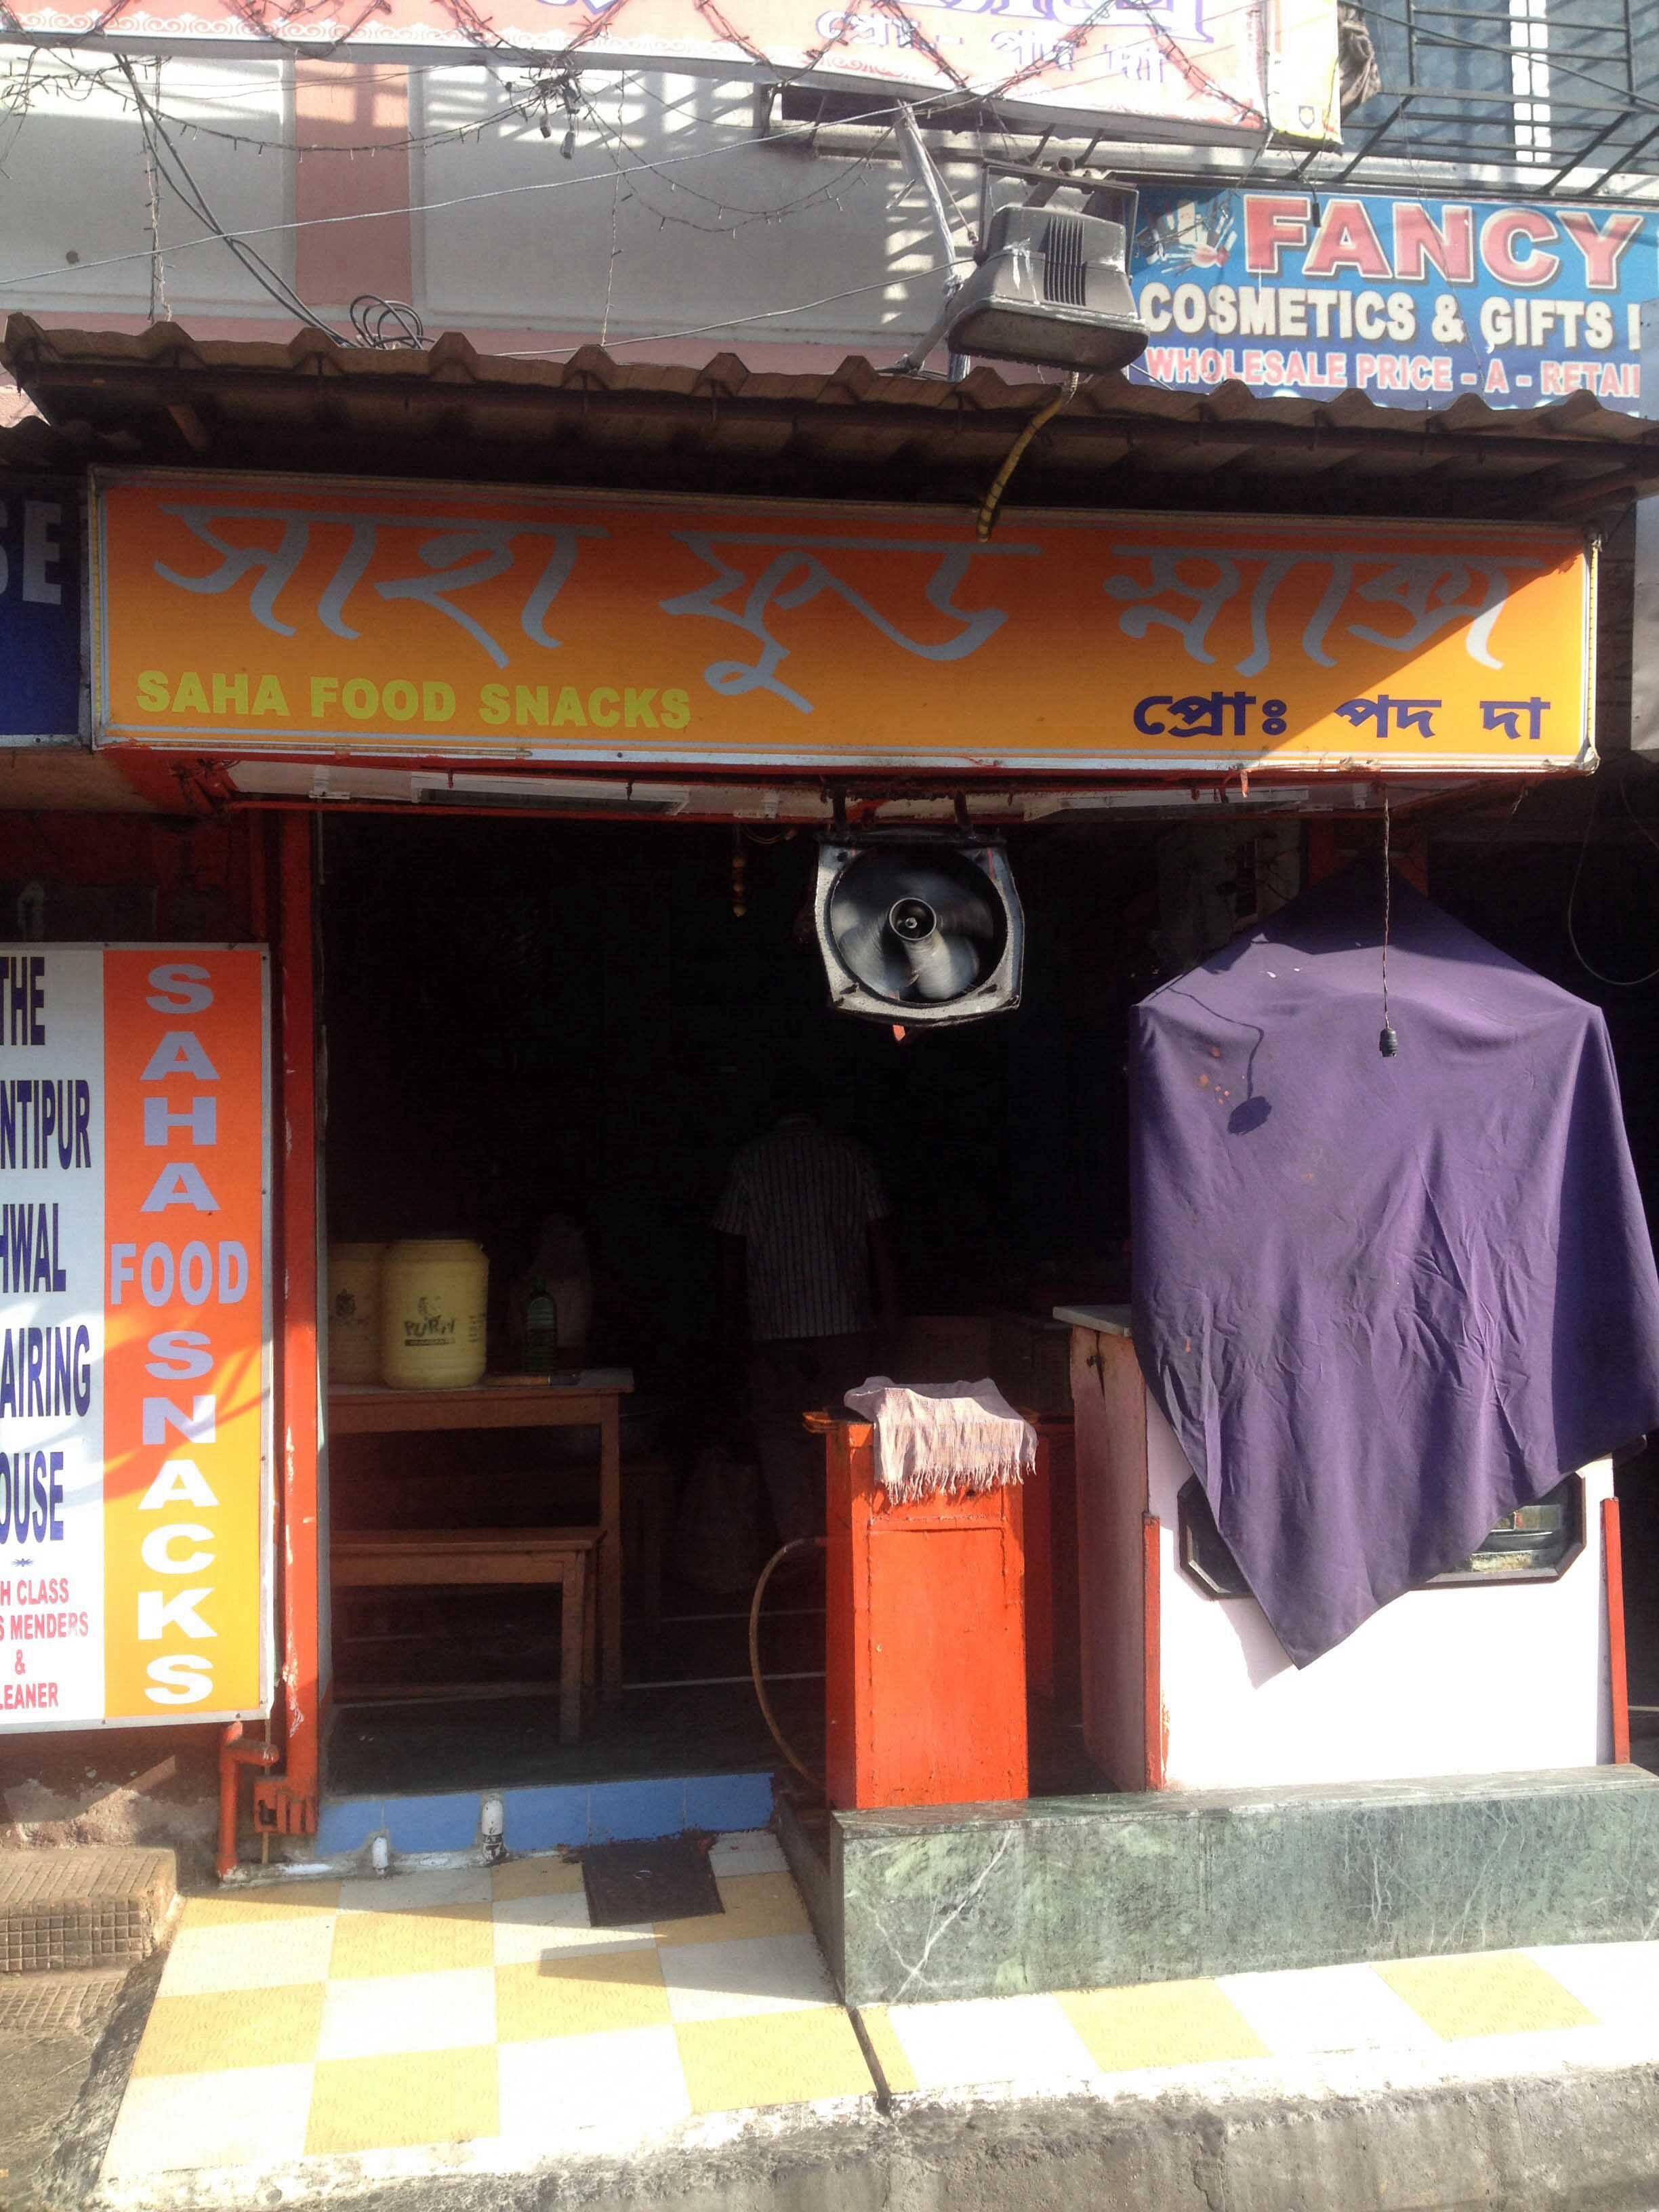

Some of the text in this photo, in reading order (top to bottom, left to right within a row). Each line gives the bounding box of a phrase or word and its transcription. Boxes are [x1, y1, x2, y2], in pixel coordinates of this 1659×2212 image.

[1244, 194, 1645, 290] FANCY
[1139, 282, 1416, 340] COSMETICS
[1431, 293, 1467, 344] &
[1479, 296, 1614, 350] GIFTS
[1145, 346, 1347, 388] WHOLESALE
[1357, 353, 1454, 392] PRICE
[1484, 358, 1510, 394] A
[153, 502, 609, 670] সাহা
[658, 531, 1044, 716] ফুড
[135, 670, 693, 731] SAHA FOOD SNACKS
[1132, 691, 1552, 740] প্রোঃ পদ দা
[140, 962, 221, 1213] SAHA
[0, 1080, 91, 1170] NTIPUR
[110, 1240, 249, 1308] FOOD
[0, 1324, 91, 1418] AIRING
[138, 1330, 221, 1705] SNACKS
[10, 1611, 89, 1641] MENDERS
[16, 1578, 69, 1606] CLASS
[14, 1649, 26, 1675] &
